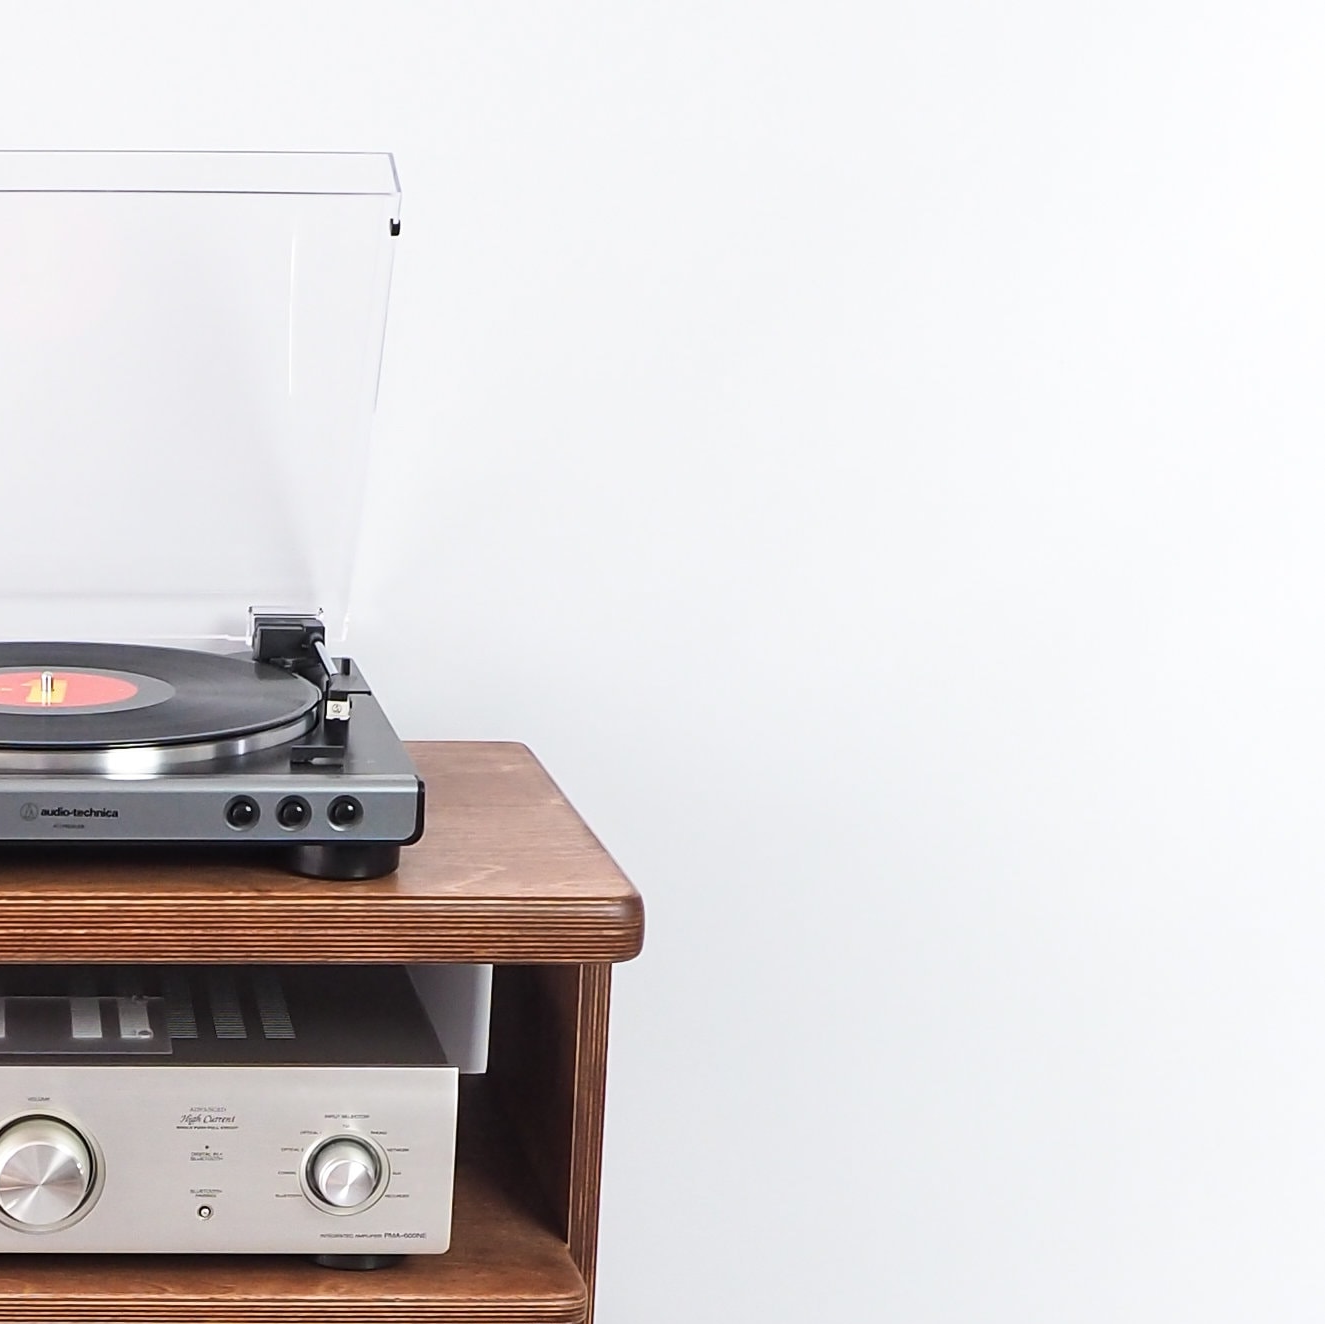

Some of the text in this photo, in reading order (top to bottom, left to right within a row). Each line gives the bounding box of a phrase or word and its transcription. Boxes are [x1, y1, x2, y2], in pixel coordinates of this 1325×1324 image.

[41, 807, 118, 818] audio-technica
[179, 1114, 236, 1125] High Current
